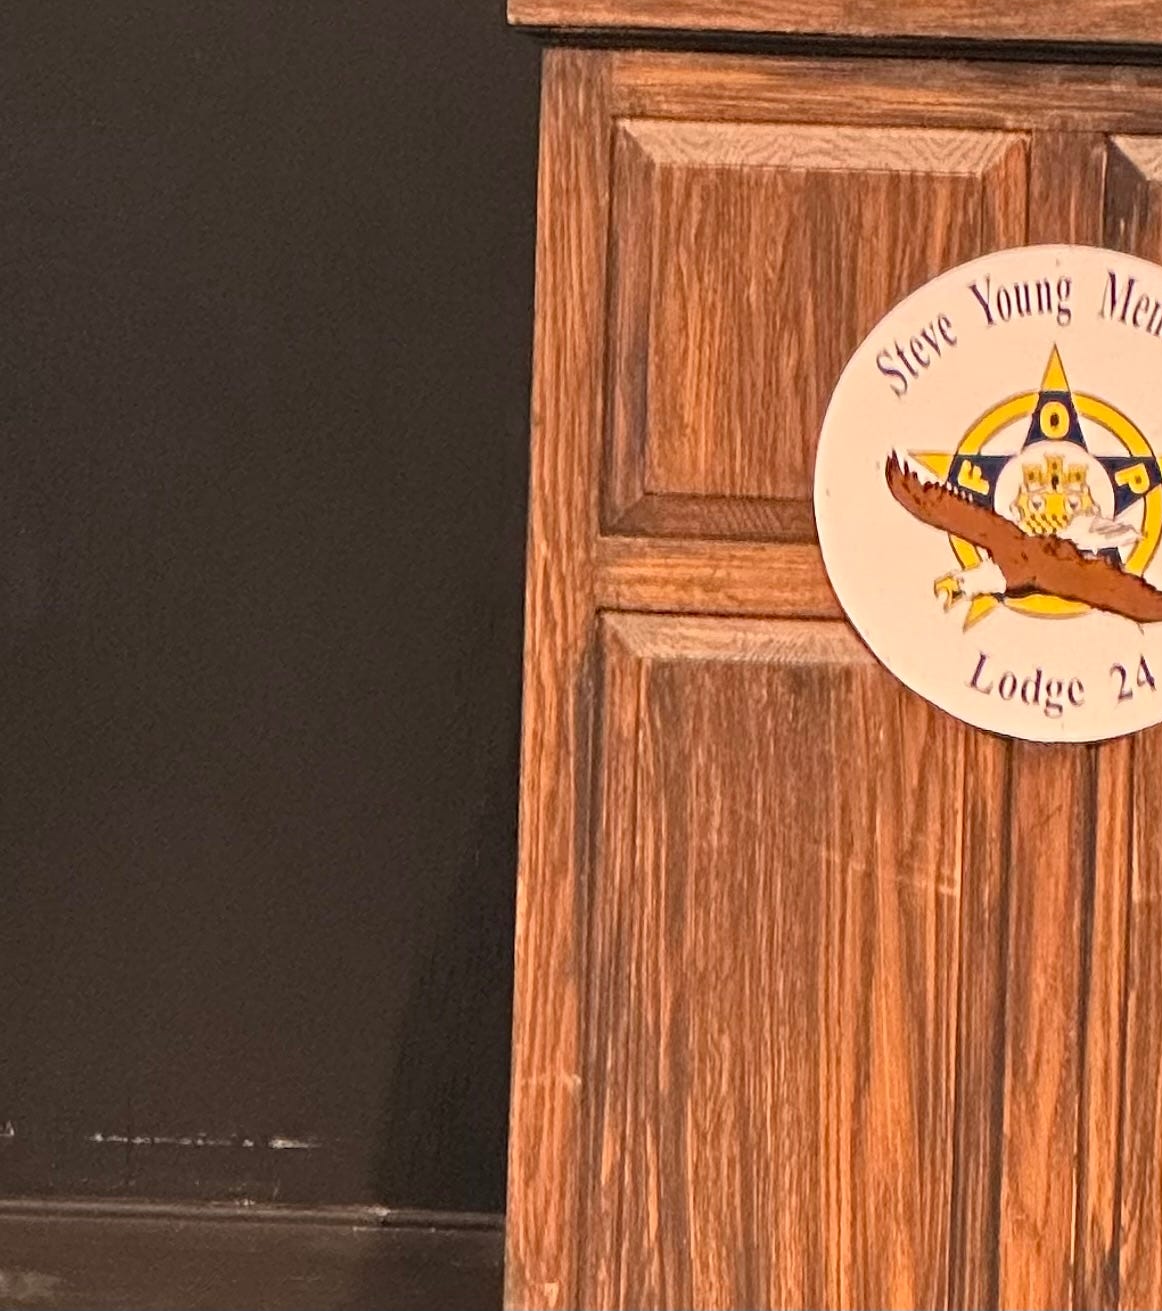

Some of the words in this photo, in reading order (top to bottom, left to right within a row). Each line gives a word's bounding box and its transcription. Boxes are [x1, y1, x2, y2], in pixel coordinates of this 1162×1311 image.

[876, 314, 958, 398] Steve
[968, 274, 1073, 328] Young
[957, 459, 990, 495] F
[1040, 401, 1070, 440] O
[1115, 463, 1150, 495] P
[966, 651, 1085, 719] Lodge
[1110, 654, 1156, 705] 24
